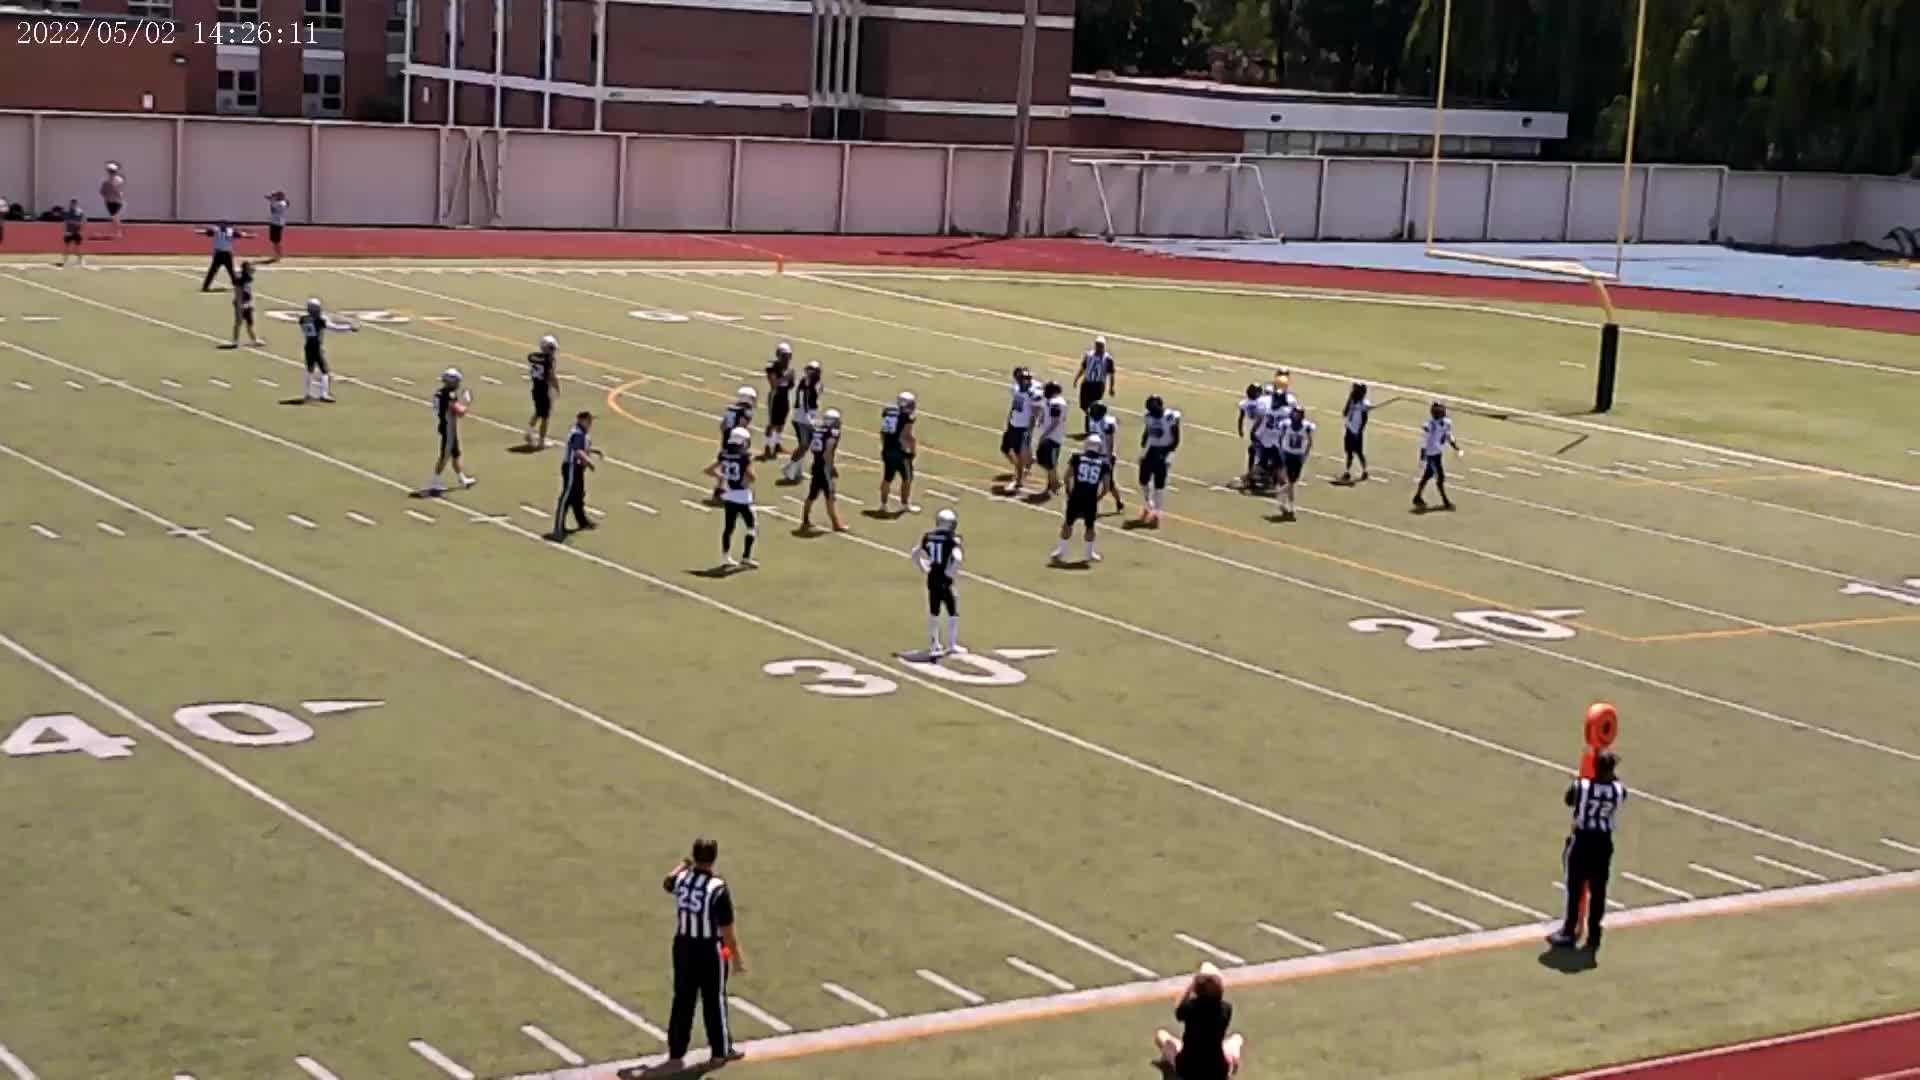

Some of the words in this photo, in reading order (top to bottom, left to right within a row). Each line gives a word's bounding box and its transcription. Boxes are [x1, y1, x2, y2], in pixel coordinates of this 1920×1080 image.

[1348, 609, 1577, 650] 20
[762, 650, 1028, 697] 30
[0, 701, 315, 759] 40
[1588, 800, 1614, 818] 72
[679, 886, 704, 913] 25
